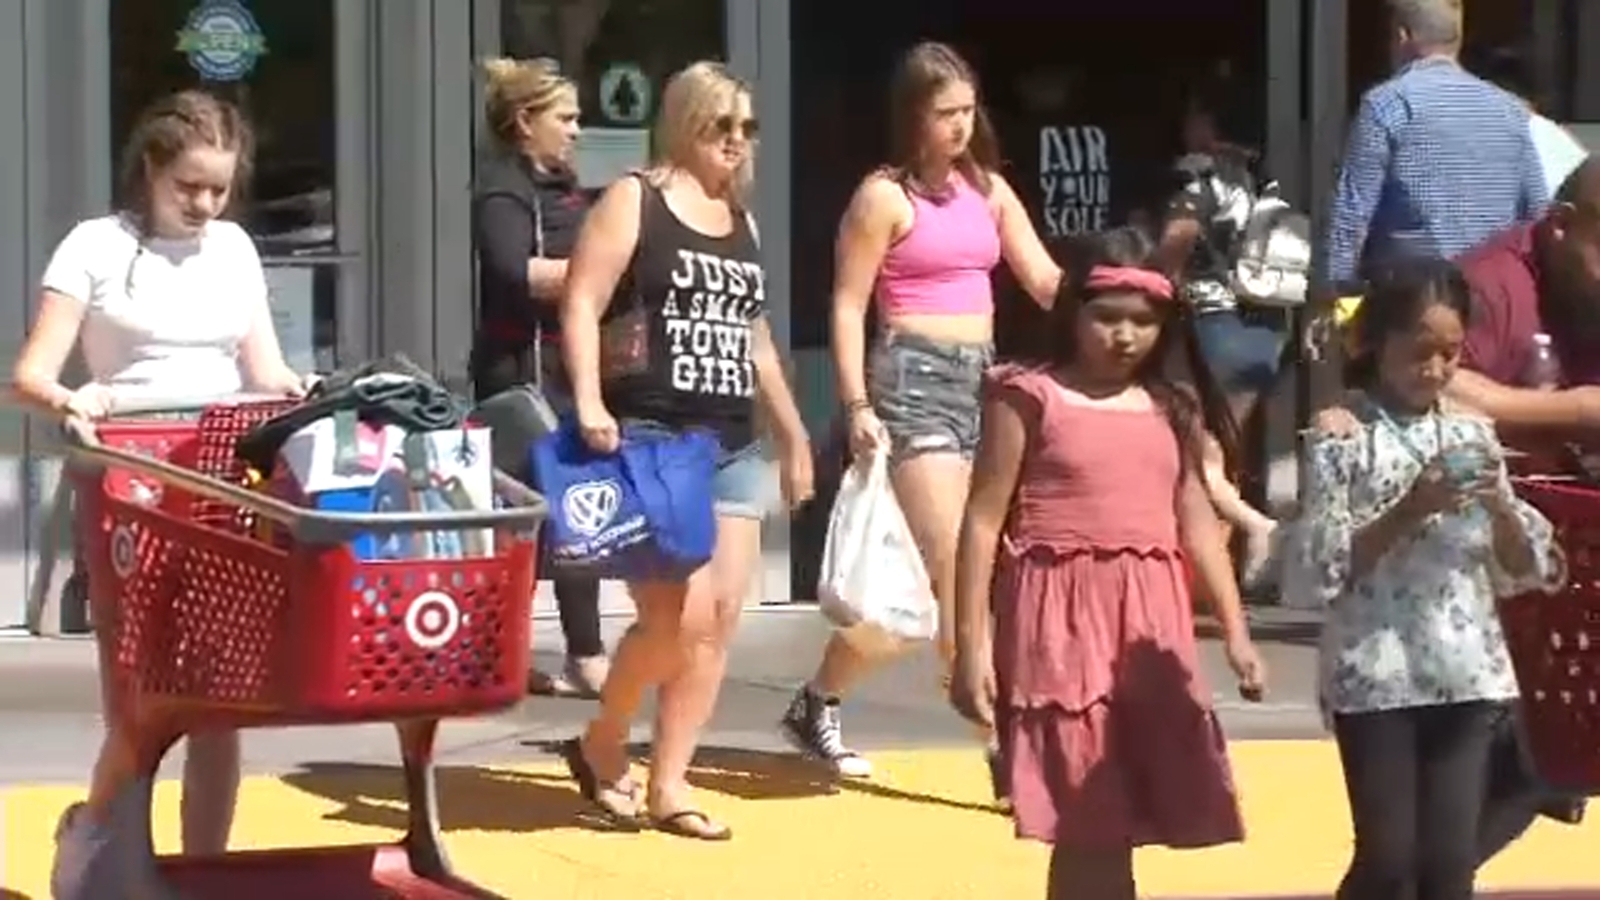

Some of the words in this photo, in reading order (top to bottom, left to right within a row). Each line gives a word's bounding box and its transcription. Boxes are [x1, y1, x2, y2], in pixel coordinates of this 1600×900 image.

[1040, 126, 1108, 172] AIR
[1040, 174, 1109, 206] YOUR
[1044, 206, 1109, 236] SOLE
[672, 249, 765, 300] JUST
[662, 289, 680, 316] A
